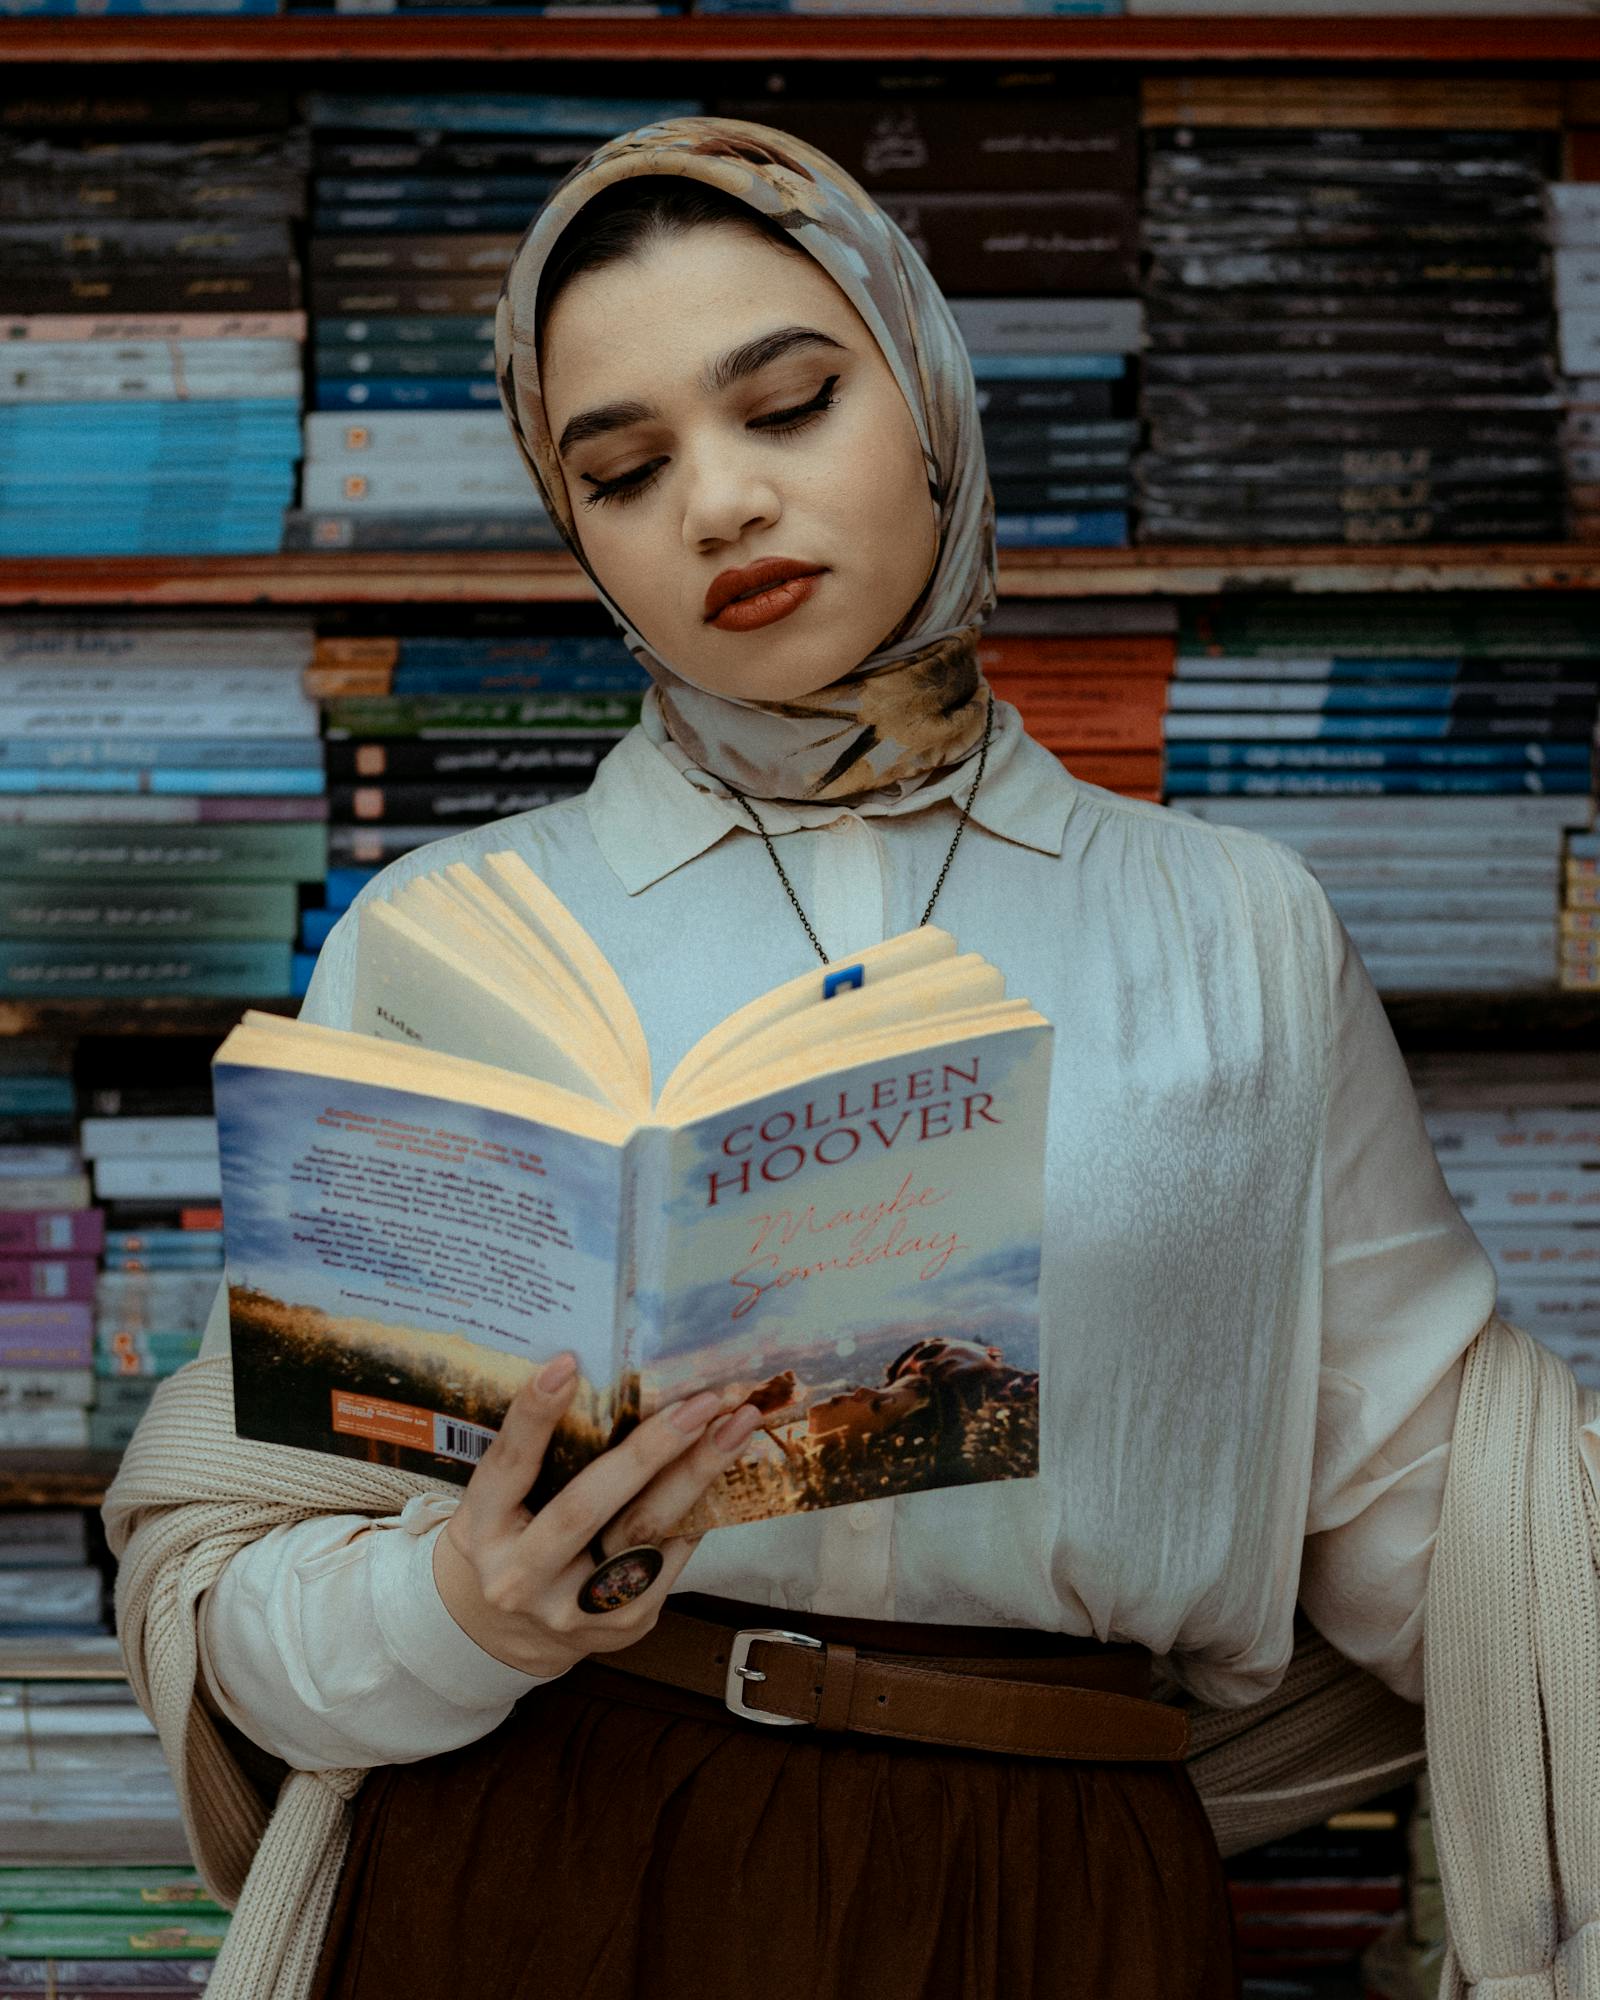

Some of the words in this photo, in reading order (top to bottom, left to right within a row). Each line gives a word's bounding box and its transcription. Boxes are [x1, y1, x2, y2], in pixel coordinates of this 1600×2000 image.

[706, 1092, 1003, 1208] HOOVER
[723, 1056, 981, 1157] COLLEEN
[748, 1171, 951, 1256] Maybe
[730, 1217, 970, 1322] Someday
